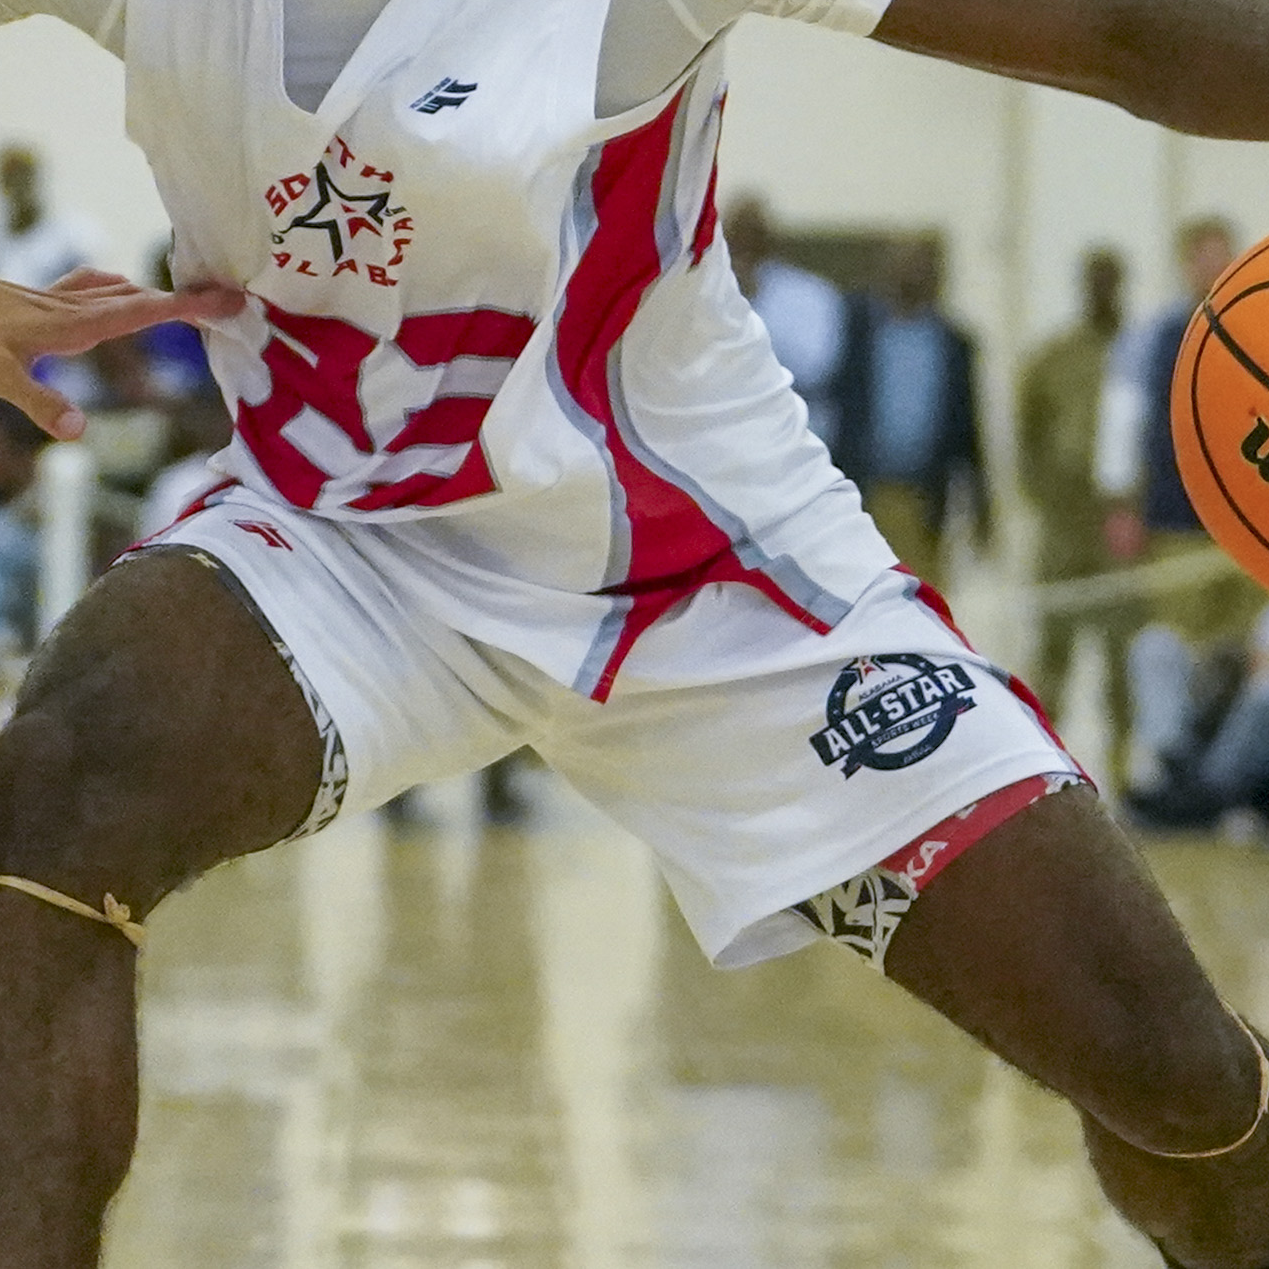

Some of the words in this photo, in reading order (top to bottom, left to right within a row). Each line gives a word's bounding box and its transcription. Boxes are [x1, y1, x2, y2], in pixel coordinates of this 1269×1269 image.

[264, 133, 395, 218] SOTH
[822, 667, 966, 759] ALL-STAR
[858, 674, 904, 701] ALABAMA
[870, 722, 910, 749] SPORTS
